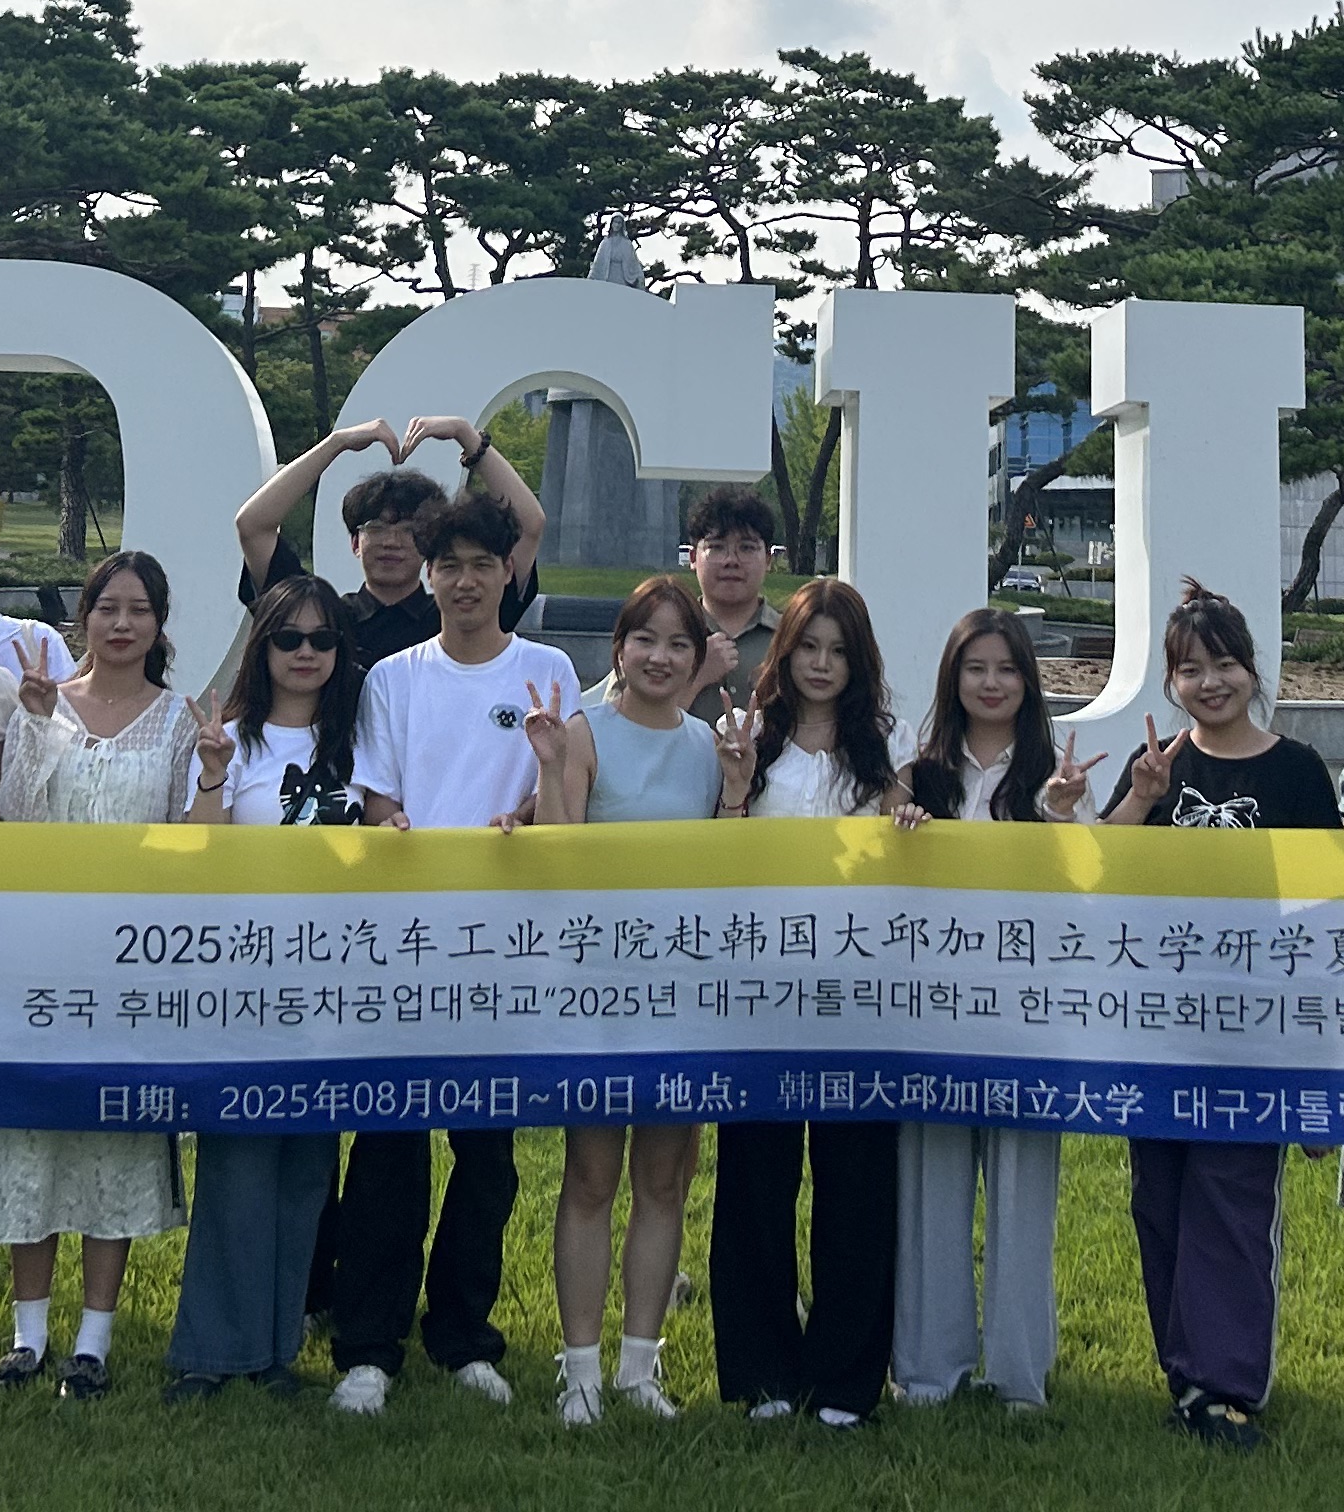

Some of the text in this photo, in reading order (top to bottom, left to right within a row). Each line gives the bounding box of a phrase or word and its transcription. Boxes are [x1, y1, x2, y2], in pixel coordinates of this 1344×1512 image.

[22, 988, 100, 1030] 중국
[698, 978, 1002, 1021] 대구가톨릭대학교
[777, 1070, 1145, 1126] 韩国大邱加图立大学
